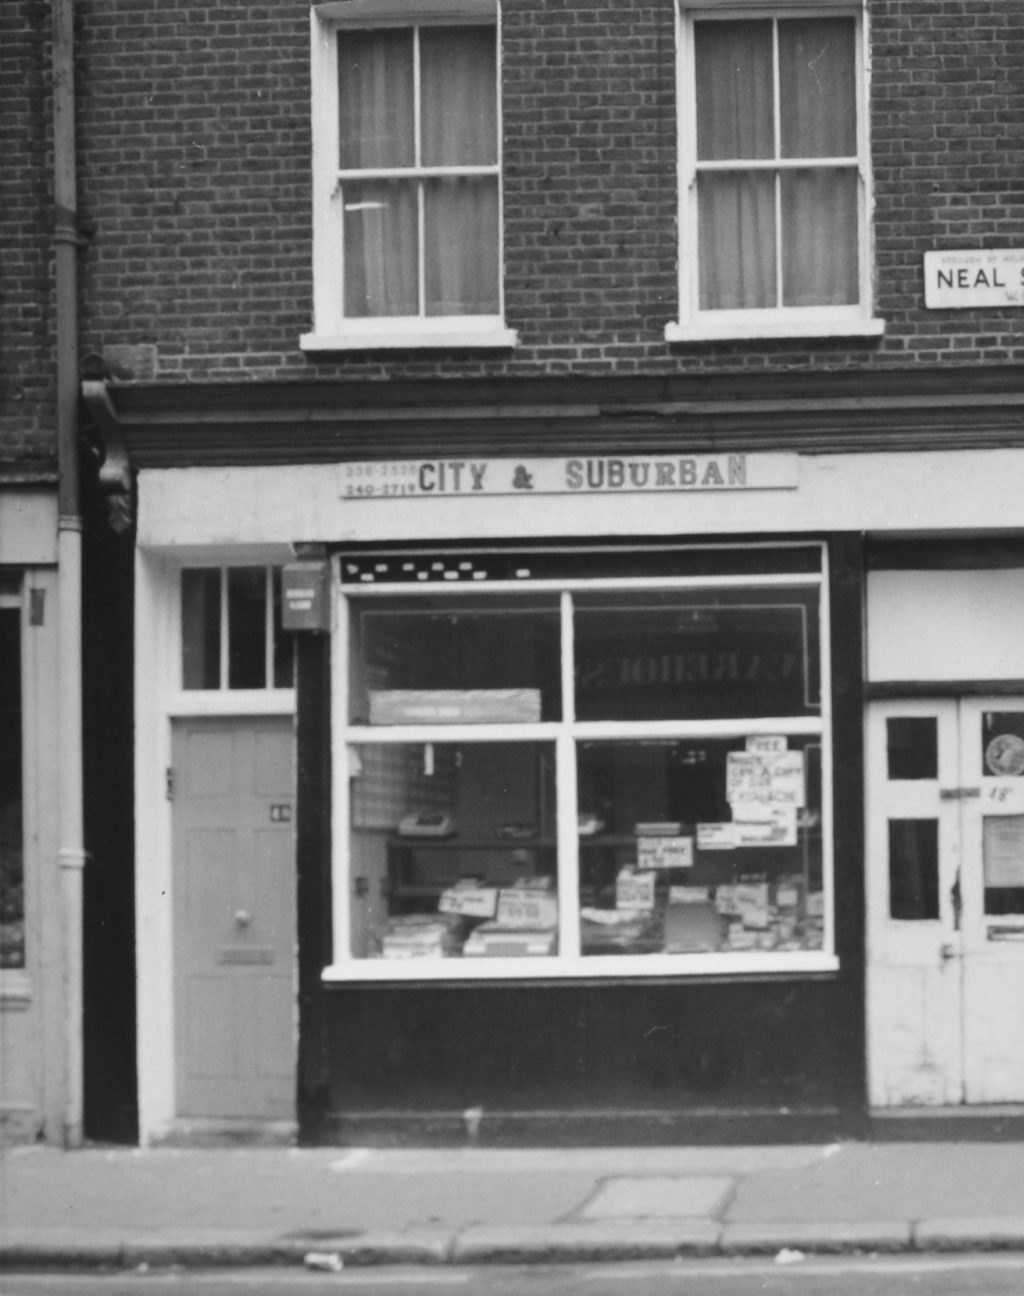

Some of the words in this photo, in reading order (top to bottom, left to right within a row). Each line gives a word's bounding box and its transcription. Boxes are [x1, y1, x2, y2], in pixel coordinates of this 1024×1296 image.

[936, 267, 1006, 289] NEAL
[418, 462, 488, 492] CITY
[512, 464, 534, 490] &
[565, 454, 747, 490] SUBURBAN
